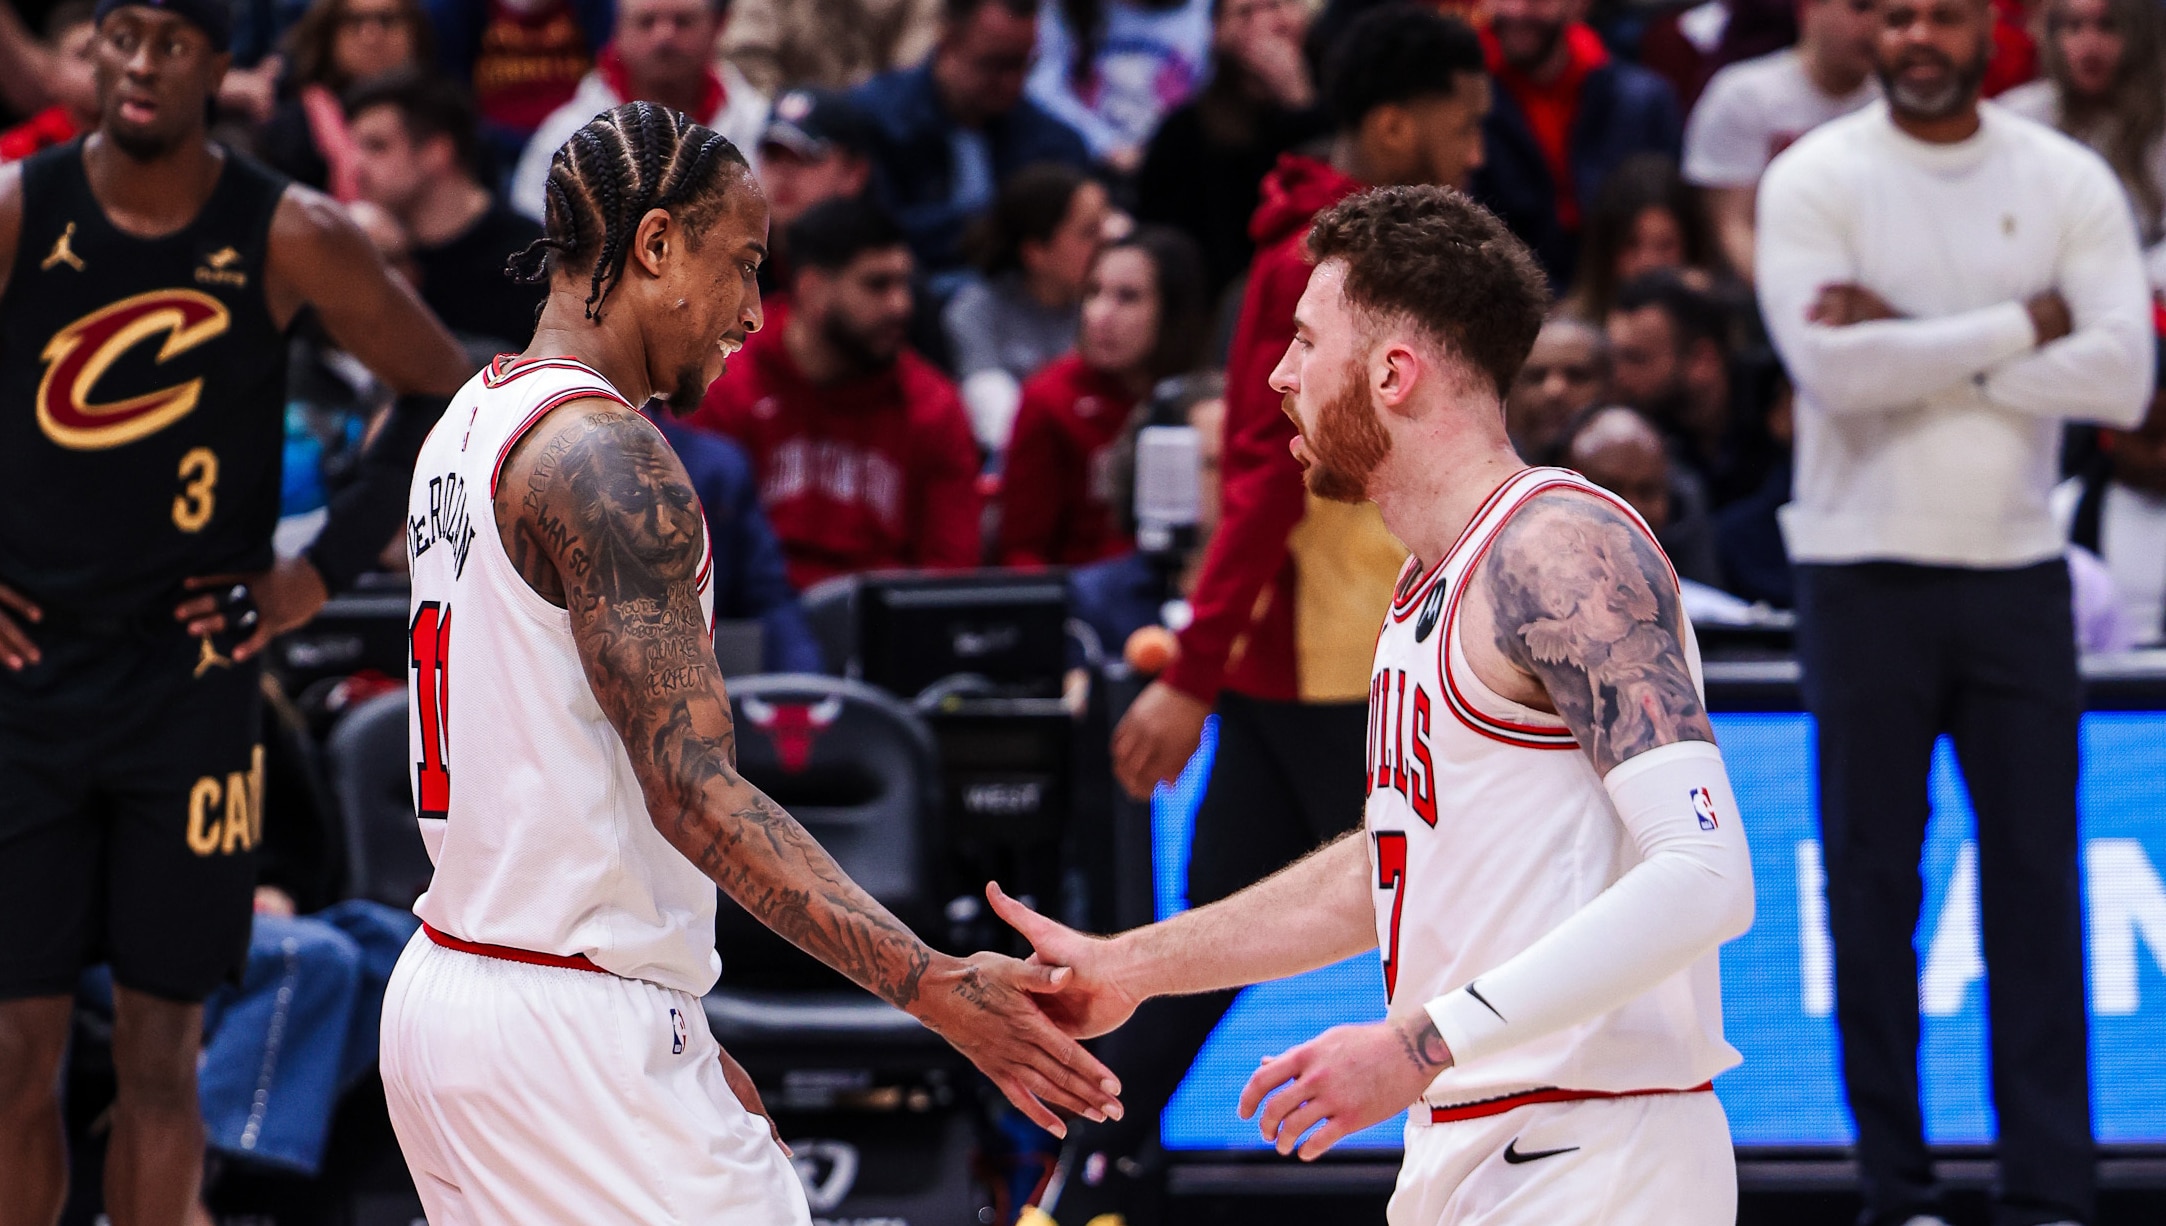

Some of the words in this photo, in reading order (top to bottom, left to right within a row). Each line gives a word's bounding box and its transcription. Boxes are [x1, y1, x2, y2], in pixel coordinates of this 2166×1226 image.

[36, 288, 230, 451] C
[172, 446, 220, 533] 3
[536, 503, 578, 561] WHY
[409, 601, 451, 820] 11
[1366, 667, 1438, 830] ULLS
[1372, 830, 1407, 1005] 7
